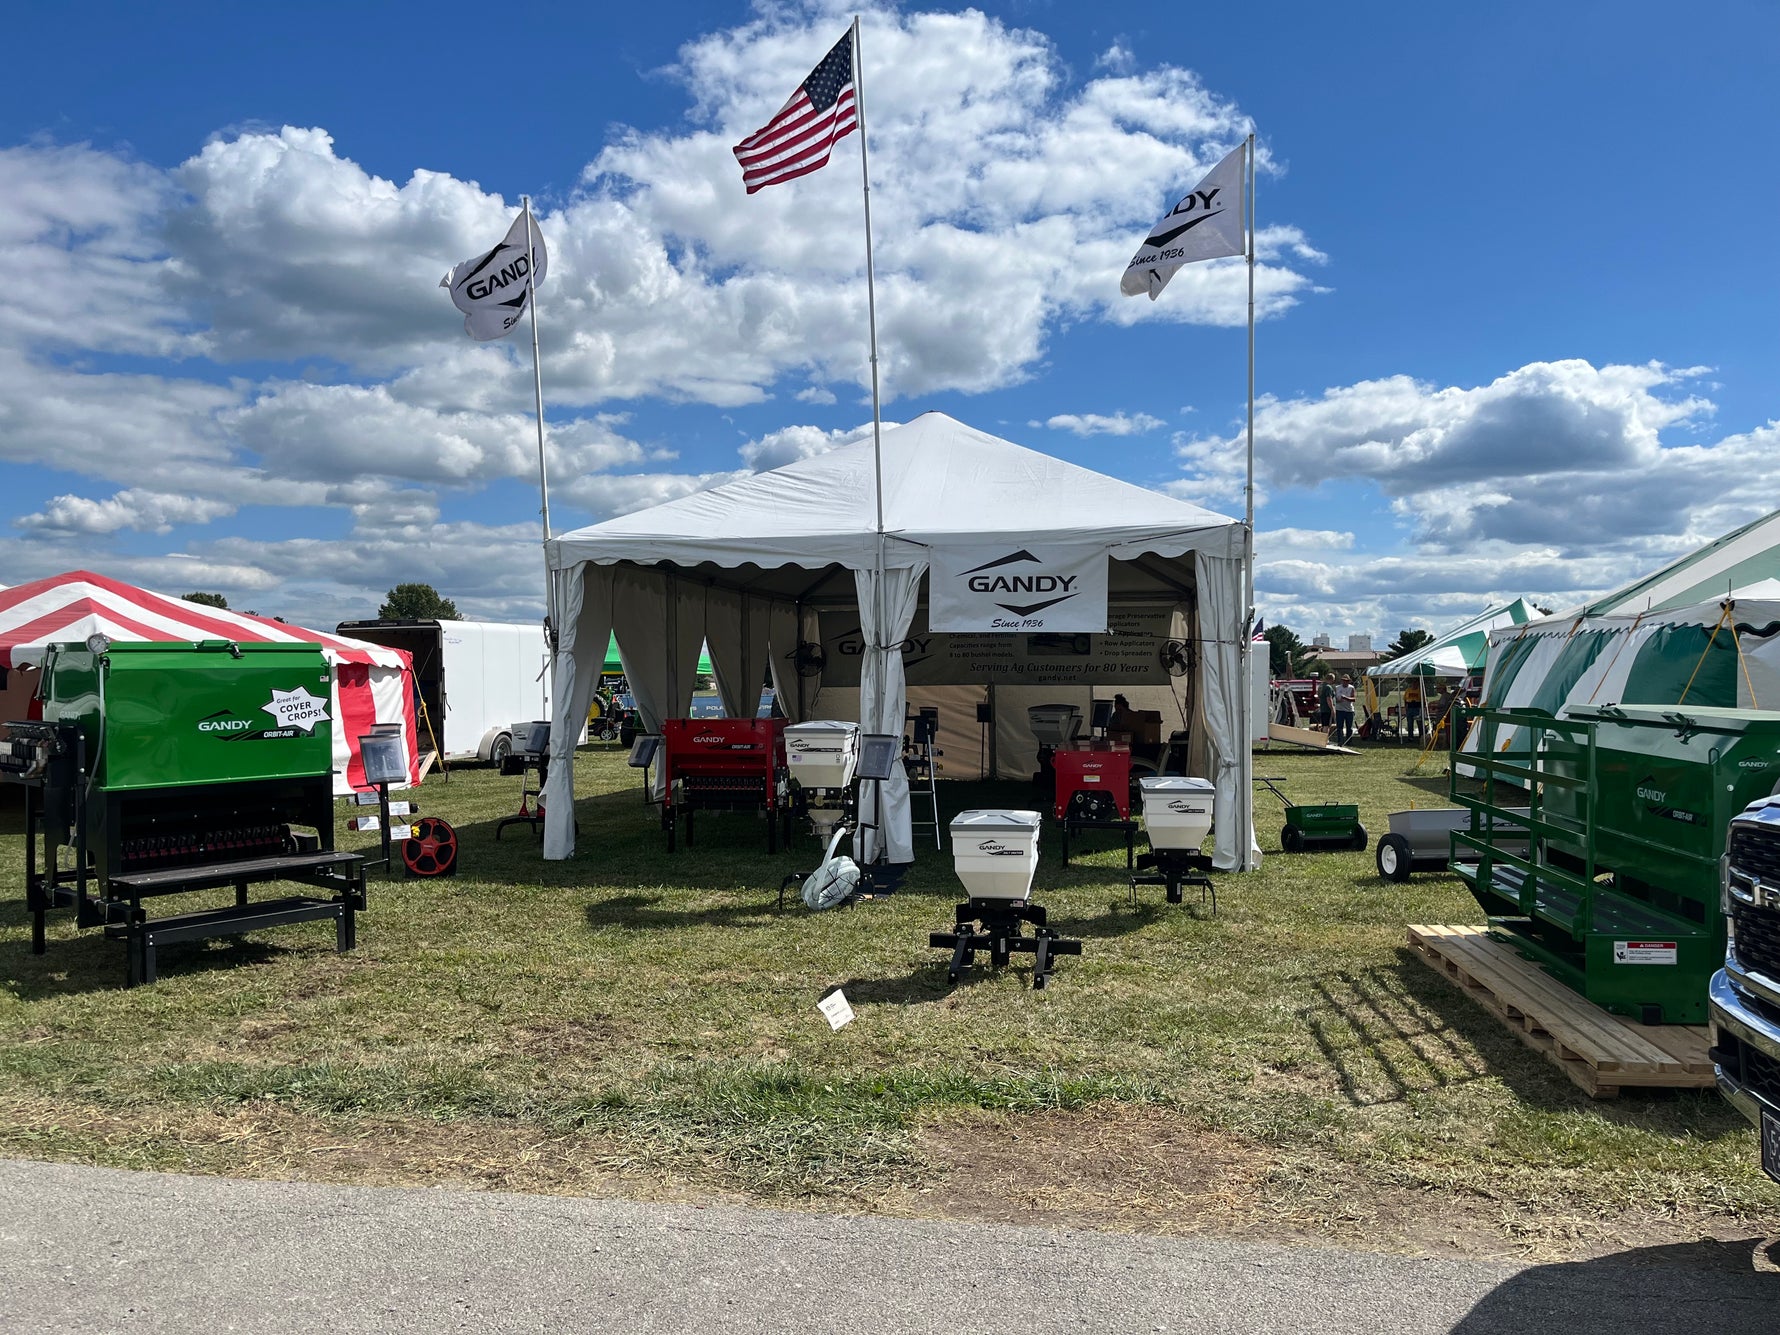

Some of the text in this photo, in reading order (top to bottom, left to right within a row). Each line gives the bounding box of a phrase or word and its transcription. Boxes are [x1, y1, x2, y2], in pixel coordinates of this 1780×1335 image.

[1159, 247, 1186, 262] 1936
[968, 575, 1078, 592] GANDY
[991, 618, 1045, 628] Since 1936
[1119, 640, 1155, 648] Applicators
[1104, 650, 1153, 658] Drop Spreaders
[969, 662, 1150, 673] Serving Ag Customers for 80 Years
[280, 701, 312, 714] COVER
[287, 708, 322, 722] CROPS!
[198, 720, 253, 731] GANDY
[263, 730, 295, 739] ORBIT-AIR
[1636, 786, 1667, 802] GANDY
